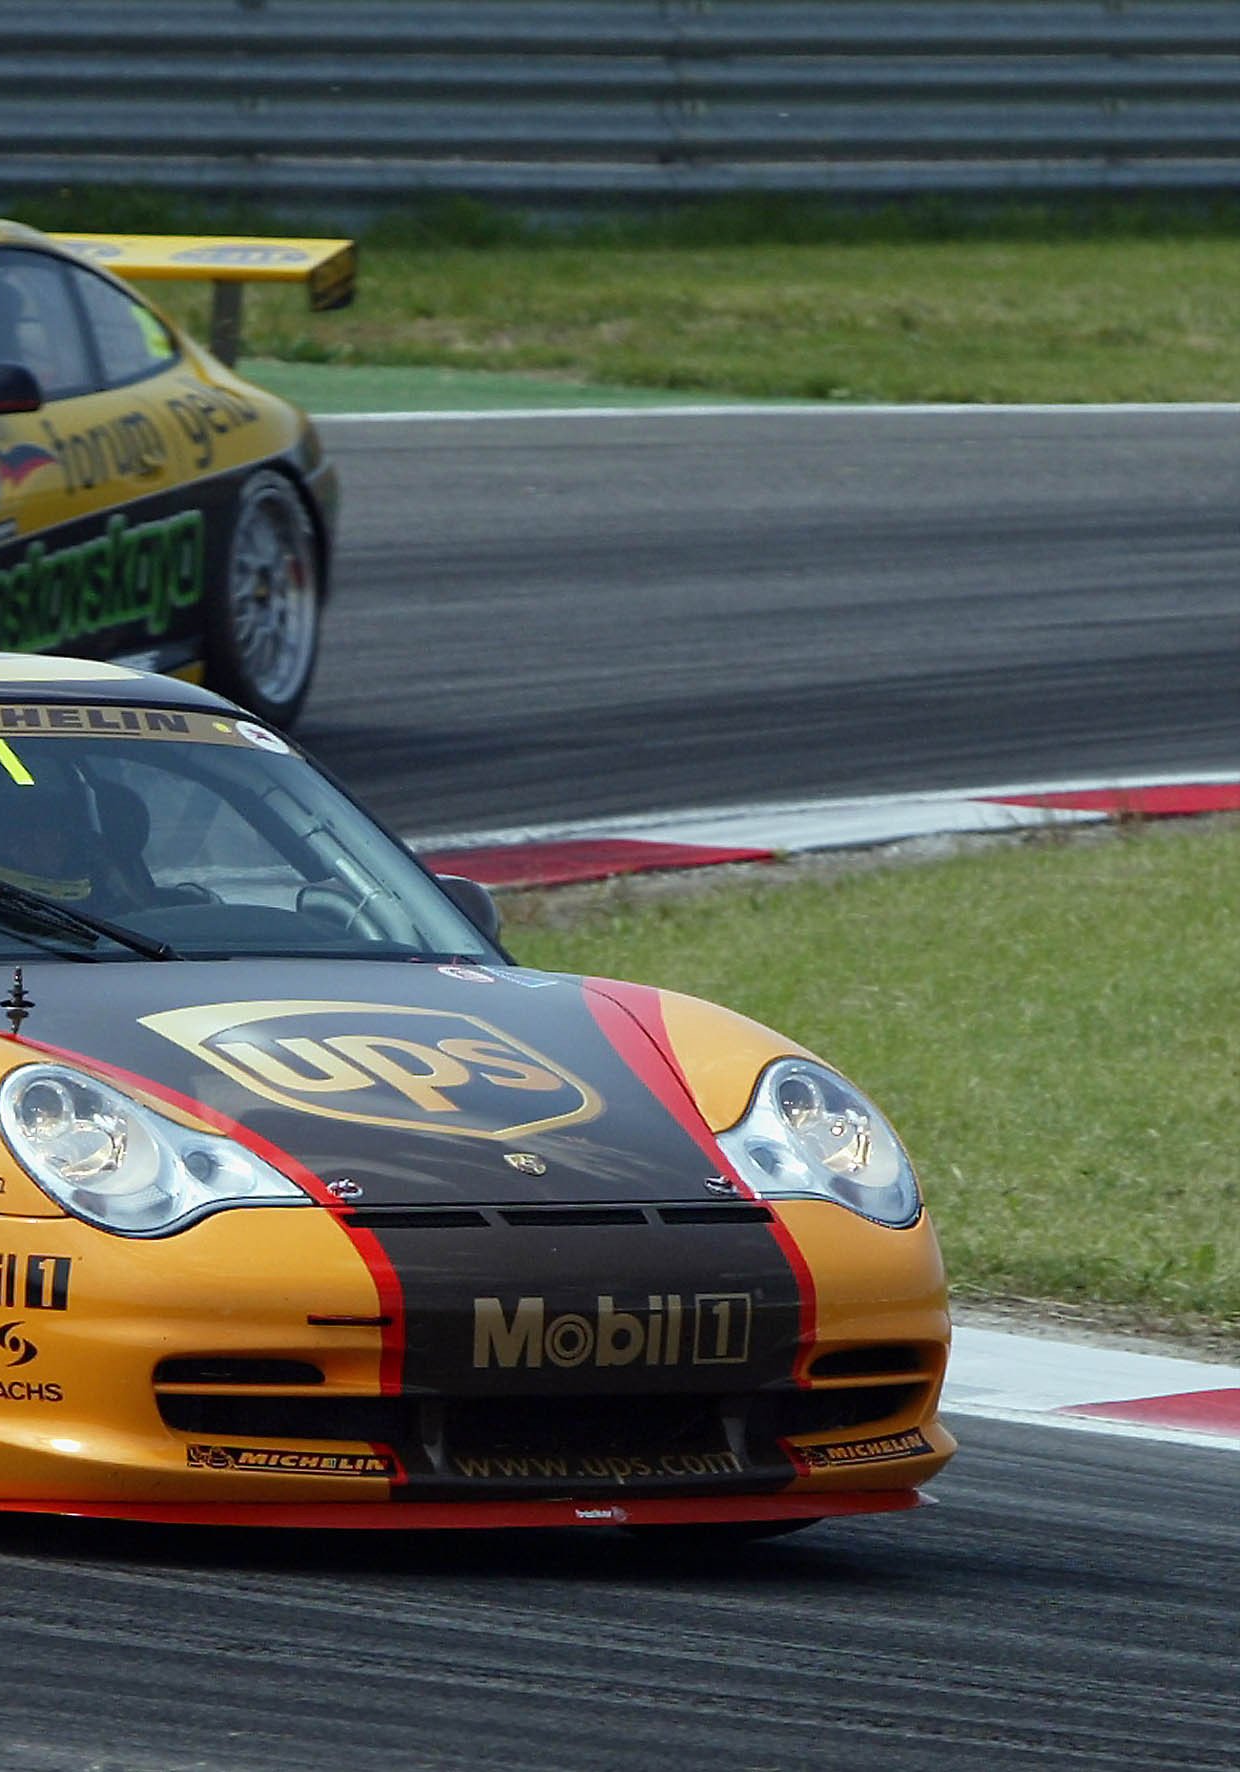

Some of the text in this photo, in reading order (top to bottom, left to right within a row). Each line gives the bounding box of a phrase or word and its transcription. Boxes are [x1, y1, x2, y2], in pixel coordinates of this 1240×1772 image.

[215, 1035, 566, 1113] ups
[472, 1294, 683, 1369] Mobil
[238, 1451, 388, 1471] MICHELIN
[826, 1433, 924, 1459] MICHELIN
[455, 1450, 744, 1486] www.ups.com
